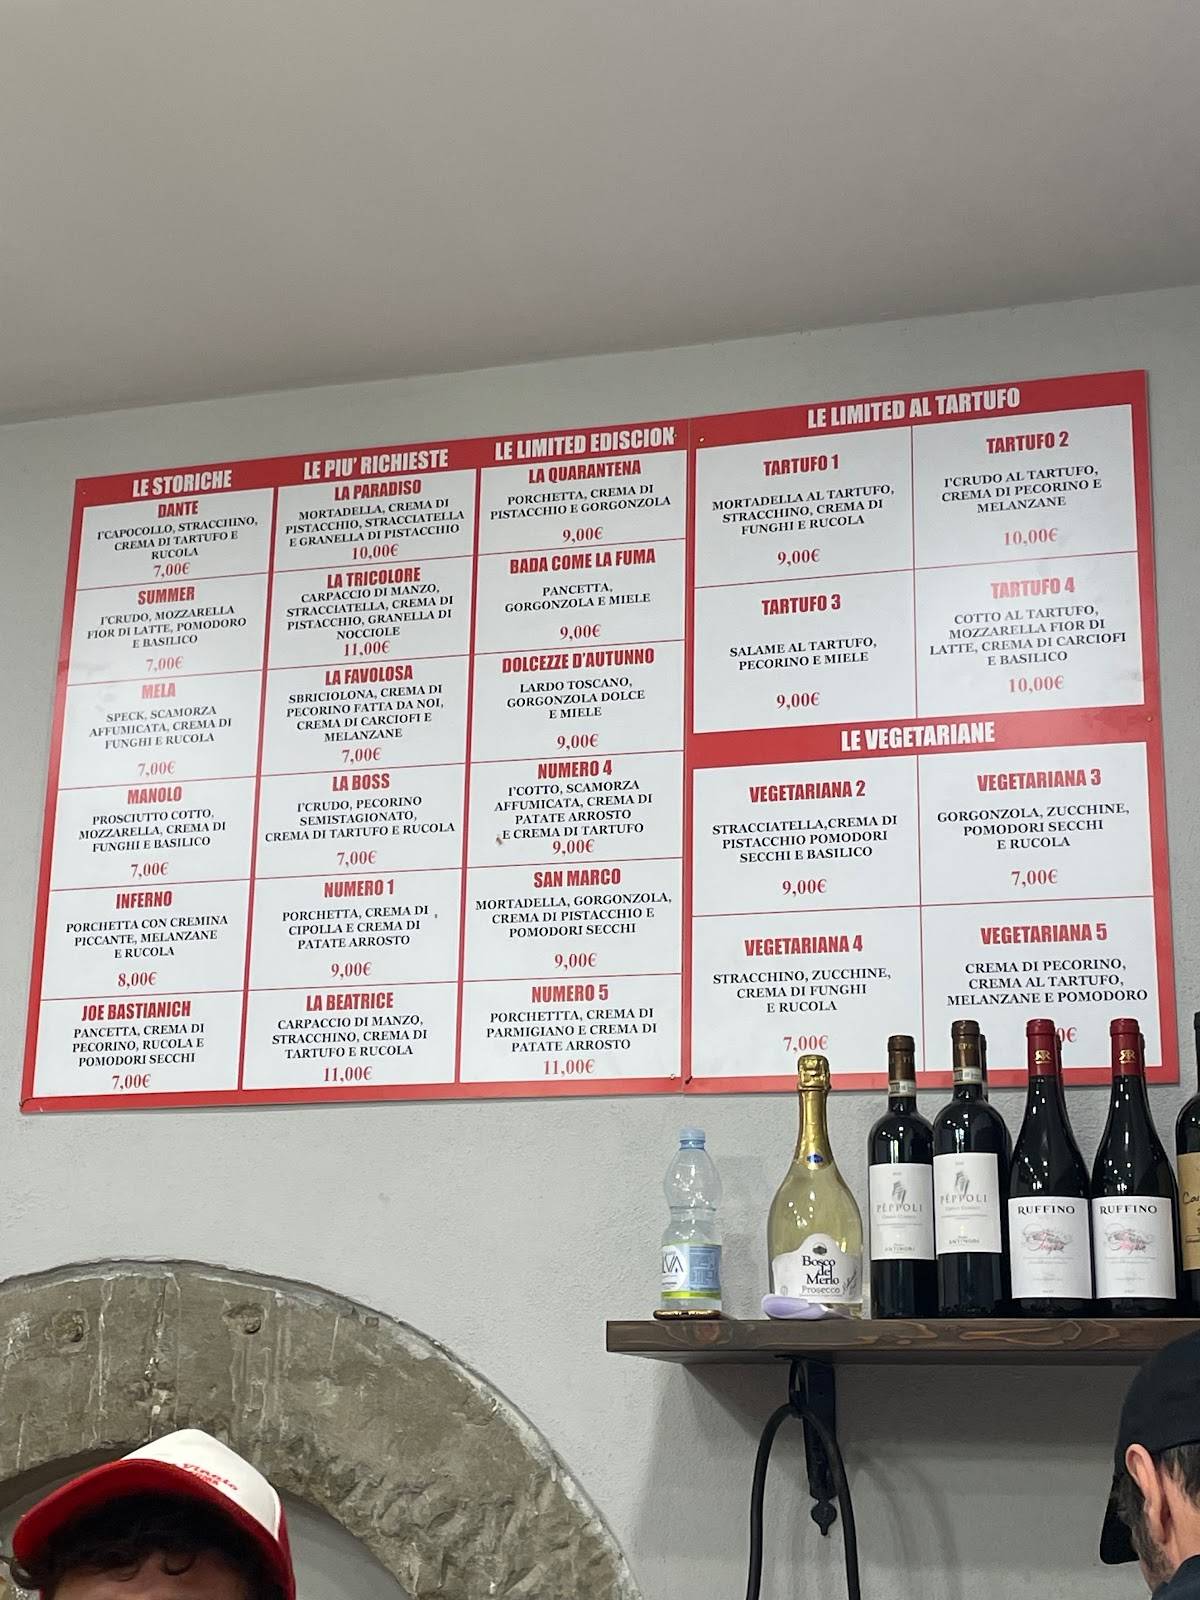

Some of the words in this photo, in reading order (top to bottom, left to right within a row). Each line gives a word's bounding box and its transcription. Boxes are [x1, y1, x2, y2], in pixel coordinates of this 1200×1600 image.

[808, 408, 826, 429] LE
[831, 400, 905, 426] LIMITED
[909, 397, 932, 418] AL
[935, 387, 1020, 415] TARTUFO
[495, 441, 513, 460] LE
[517, 435, 586, 459] LIMITED
[590, 426, 674, 452] EDISCION
[986, 432, 1055, 454] TARTUFO
[1058, 430, 1069, 447] 2
[304, 461, 321, 480] LE
[360, 448, 448, 474] RICHIESTE
[528, 468, 545, 484] LA
[548, 459, 642, 484] QUARANTENA
[763, 455, 828, 476] TARTUFO
[831, 454, 838, 470] 1
[132, 479, 149, 497] LE
[152, 469, 232, 495] STORICHE
[334, 485, 350, 501] LA
[352, 479, 422, 500] PARADISO
[712, 493, 804, 511] MORTADELLA
[806, 491, 825, 502] AL
[826, 484, 894, 499] TARTUFO,
[977, 496, 1066, 513] MELANZANE
[157, 500, 199, 519] DANTE
[490, 505, 567, 520] PISTACCHIO
[570, 504, 578, 514] E
[580, 496, 671, 513] GORGONZOLA
[285, 519, 363, 535] PISTACCHIO,
[364, 510, 465, 528] STRACCIATELLA
[114, 538, 155, 551] CREMA
[158, 537, 171, 547] DI
[173, 531, 228, 545] TARTUFO
[230, 530, 238, 540] E
[562, 526, 604, 542] 9,00€
[1005, 527, 1059, 546] 10,00€
[151, 547, 198, 560] RUCOLA
[353, 543, 400, 560] 10,00€
[777, 548, 820, 565] 9,00€
[153, 562, 191, 577] 7,00€
[510, 556, 548, 574] BADA
[551, 553, 592, 571] COME
[595, 551, 612, 568] LA
[615, 548, 656, 566] FUMA
[326, 573, 343, 589] LA
[345, 566, 421, 588] TRICOLORE
[137, 586, 195, 606] SUMMER
[542, 582, 613, 596] PANCETTA,
[990, 577, 1061, 600] TARTUFO
[1064, 576, 1075, 593] 4
[761, 594, 827, 616] TARTUFO
[831, 593, 841, 610] 3
[336, 626, 400, 640] NOCCIOLE
[560, 624, 600, 639] 9,00€
[344, 640, 390, 657] 11,00€
[729, 643, 786, 657] SALAME
[788, 642, 806, 653] AL
[808, 637, 877, 651] TARTUFO,
[502, 653, 569, 674] DOLCEZZE
[325, 670, 341, 686] LA
[344, 664, 413, 685] FAVOLOSA
[141, 682, 176, 700] MELA
[507, 693, 598, 708] GORGONZOLA
[601, 689, 645, 702] DOLCE
[776, 692, 821, 709] 9,00€
[150, 705, 217, 719] SCAMORZA
[324, 728, 403, 742] MELANZANE
[557, 733, 599, 749] 9,00€
[841, 729, 861, 752] LE
[864, 720, 996, 750] VEGETARIANE
[341, 747, 382, 763] 7,00€
[537, 760, 599, 780] NUMERO
[602, 759, 613, 776] 4
[332, 775, 349, 792] LA
[351, 773, 390, 791] BOSS
[977, 768, 1087, 792] VEGETARIANA
[1090, 768, 1102, 786] 3
[127, 786, 182, 805] MANOLO
[749, 781, 853, 803] VEGETARIANA
[855, 779, 866, 797] 2
[92, 811, 168, 825] PROSCIUTTO
[171, 809, 214, 820] COTTO,
[299, 810, 417, 826] SEMISTAGIONATO,
[515, 812, 565, 825] PATATE
[568, 809, 631, 822] ARROSTO
[937, 807, 1043, 823] GORGONZOLA,
[1047, 803, 1130, 817] ZUCCHINE,
[552, 839, 596, 855] 9,00€
[722, 835, 806, 849] PISTACCHIO
[810, 830, 887, 845] POMODORI
[336, 850, 378, 866] 7,00€
[130, 862, 170, 877] 7,00€
[533, 870, 563, 888] SAN
[566, 868, 621, 887] MARCO
[1011, 868, 1058, 886] 7,00€
[324, 879, 384, 898] NUMERO
[387, 878, 394, 895] 1
[782, 878, 828, 895] 9,00€
[115, 890, 173, 909] INFERNO
[475, 897, 570, 910] MORTADELLA,
[573, 892, 672, 906] GORGONZOLA,
[66, 920, 139, 933] PORCHETTA
[141, 918, 167, 929] CON
[170, 915, 228, 927] CREMINA
[297, 938, 346, 950] PATATE
[348, 935, 410, 947] ARROSTO
[980, 923, 1093, 945] VEGETARIANA
[1096, 922, 1108, 941] 5
[744, 935, 850, 957] VEGETARIANA
[852, 934, 863, 952] 4
[554, 952, 596, 968] 9,00€
[331, 962, 372, 977] 9,00€
[713, 970, 809, 984] STRACCHINO,
[811, 967, 891, 981] ZUCCHINE,
[118, 971, 158, 987] 8,00€
[306, 994, 323, 1012] LA
[326, 992, 394, 1011] BEATRICE
[531, 984, 595, 1003] NUMERO
[598, 983, 609, 1001] 5
[947, 993, 1041, 1006] MELANZANE
[1044, 992, 1054, 1003] E
[1057, 989, 1148, 1003] POMODORO
[81, 1004, 105, 1021] JOE
[107, 1000, 191, 1020] BASTIANICH
[272, 1032, 360, 1045] STRACCHINO,
[363, 1030, 410, 1041] CREMA
[413, 1029, 427, 1040] DI
[512, 1041, 563, 1052] PATATE
[566, 1039, 631, 1051] ARROSTO
[783, 1035, 829, 1051] 7,00€
[78, 1054, 146, 1067] POMODORI
[149, 1053, 195, 1064] SECCHI
[544, 1059, 596, 1075] 11,00€
[112, 1073, 152, 1089] 7,00€
[324, 1066, 373, 1082] 11,00€
[1018, 1205, 1075, 1215] RUFFINO
[1100, 1205, 1157, 1215] RUFFINO
[802, 1256, 836, 1267] Bosco
[819, 1264, 833, 1276] del
[806, 1272, 840, 1285] Merlo
[801, 1286, 841, 1294] Prosecco
